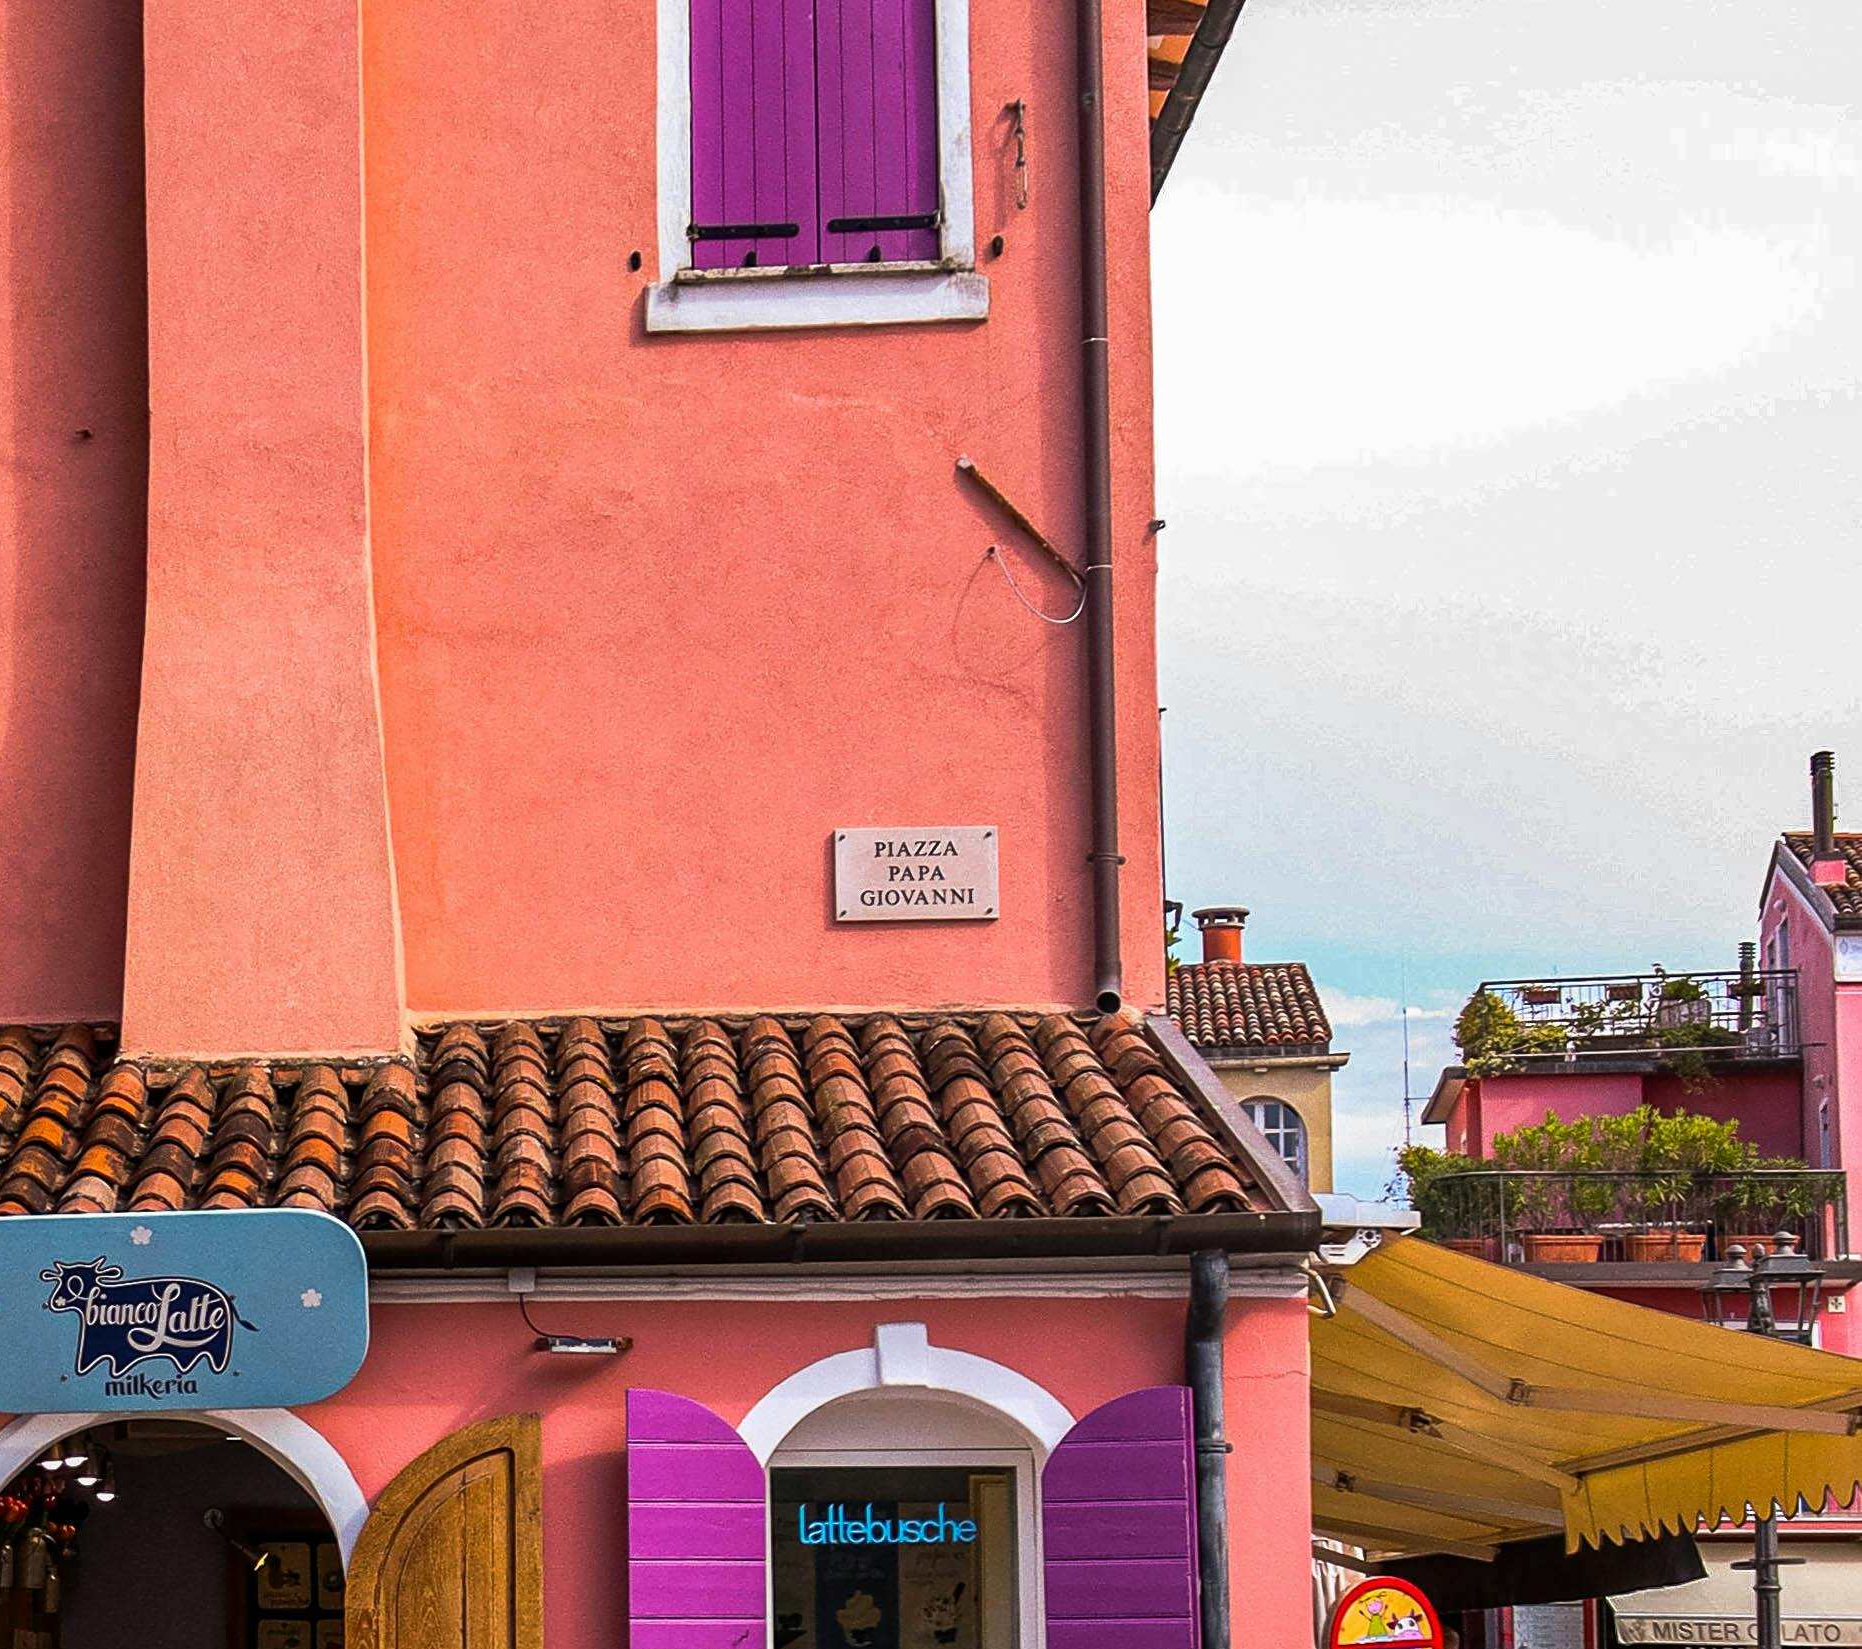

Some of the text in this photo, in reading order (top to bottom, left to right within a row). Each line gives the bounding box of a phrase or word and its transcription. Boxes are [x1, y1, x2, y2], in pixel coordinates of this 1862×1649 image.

[873, 840, 959, 858] PIAZZA
[888, 865, 945, 882] PAPA
[860, 888, 975, 906] GIOVANNI
[105, 1373, 199, 1399] milkeria
[798, 1502, 978, 1544] lattebusche
[1652, 1621, 1841, 1642] MISTER GLATO
